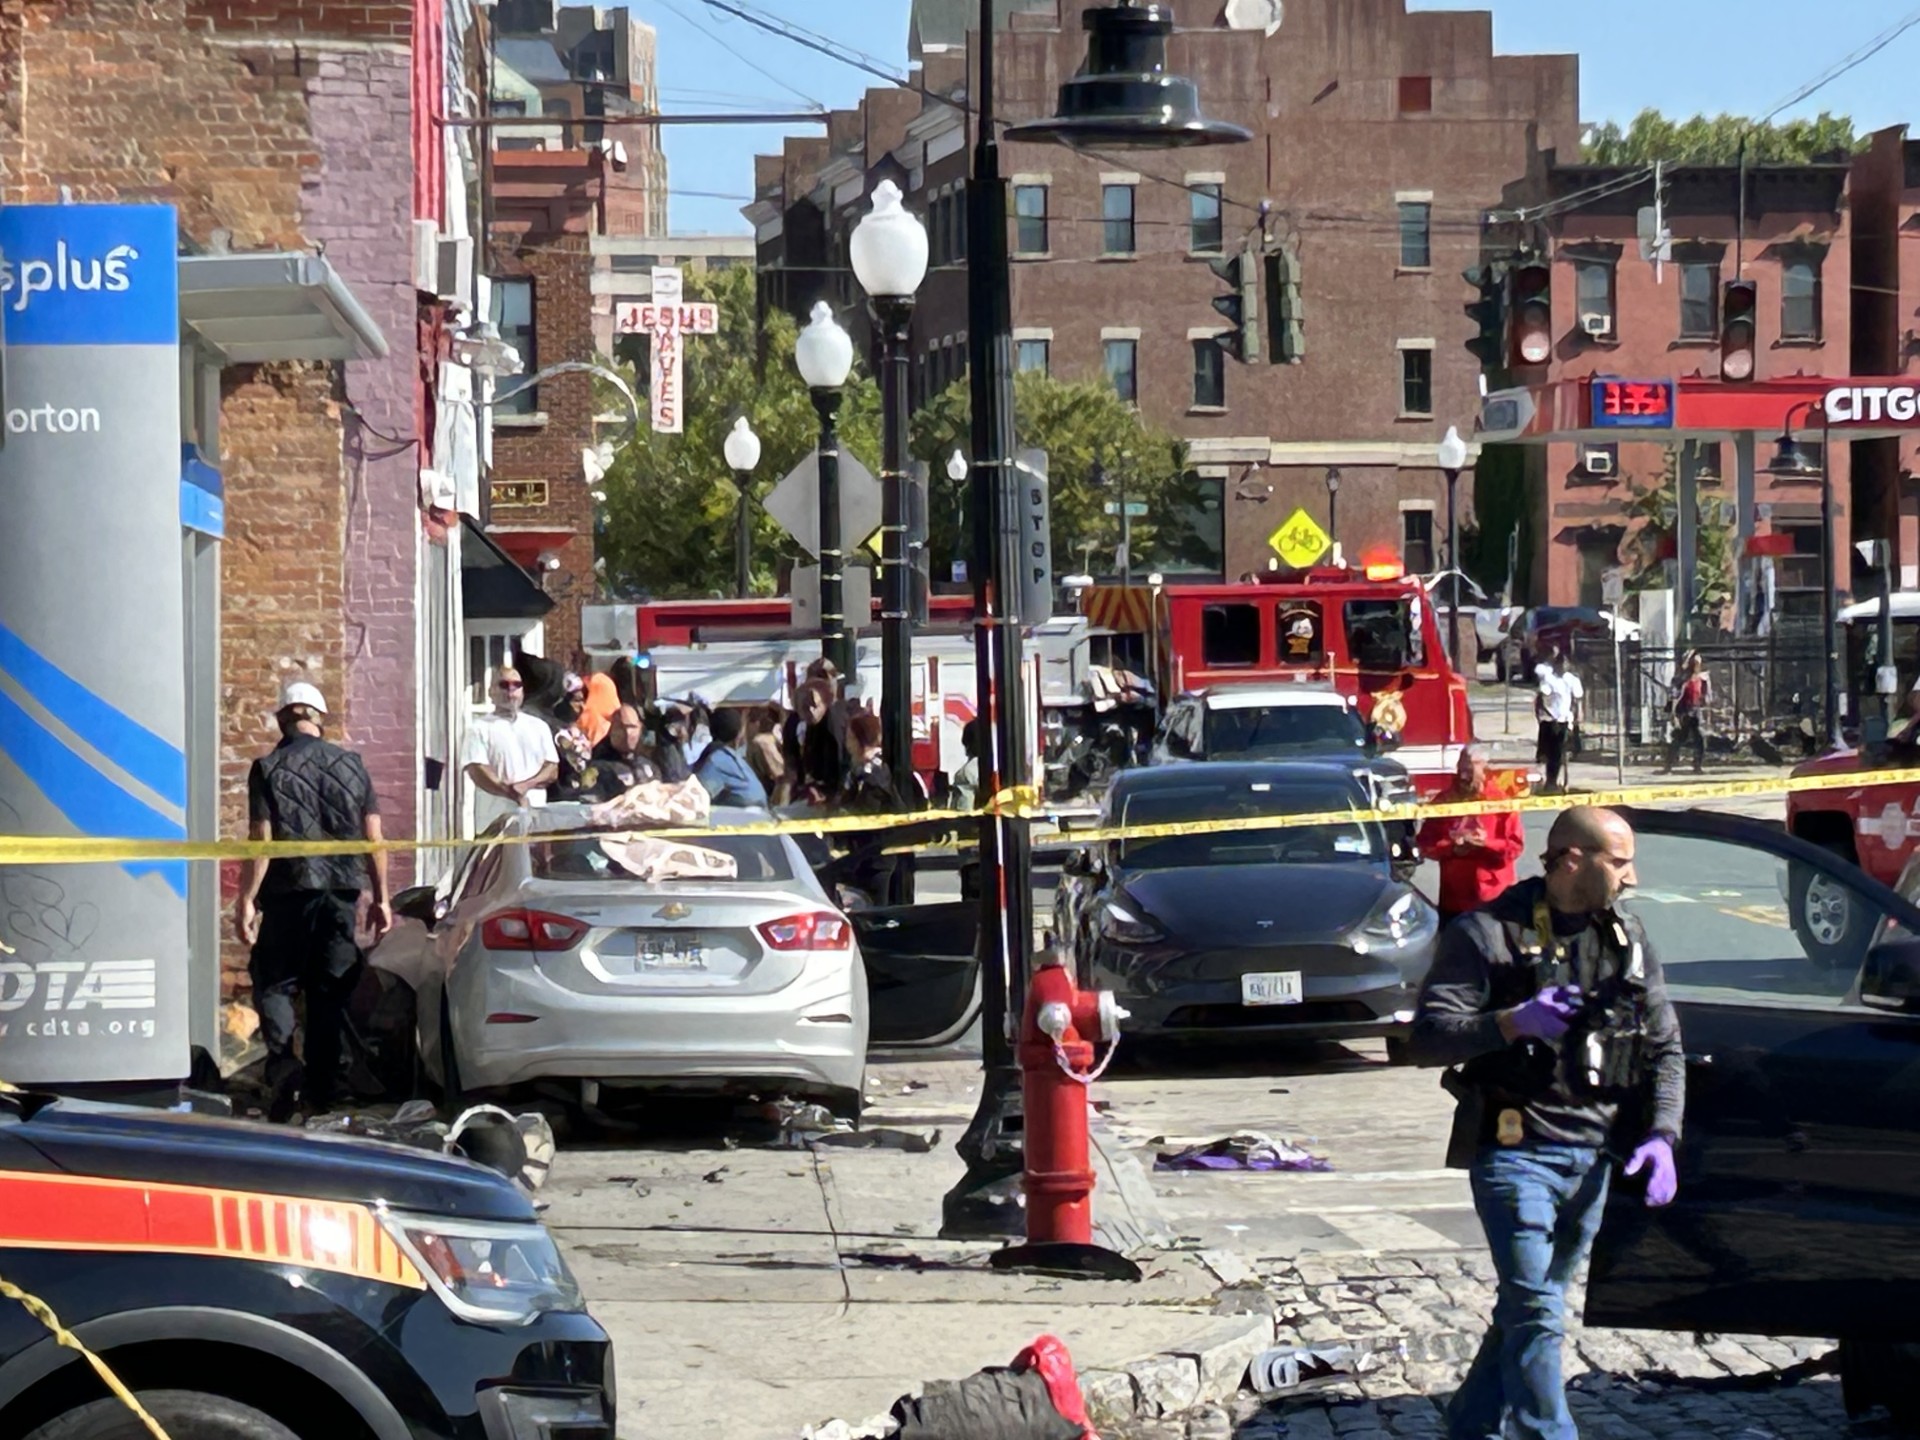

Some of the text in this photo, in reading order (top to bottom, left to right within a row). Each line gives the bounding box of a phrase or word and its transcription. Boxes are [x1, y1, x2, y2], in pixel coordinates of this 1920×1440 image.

[621, 306, 713, 330] JESUS
[1824, 387, 1920, 423] CITG
[1030, 488, 1046, 585] STOP
[26, 1018, 156, 1038] cdta.org
